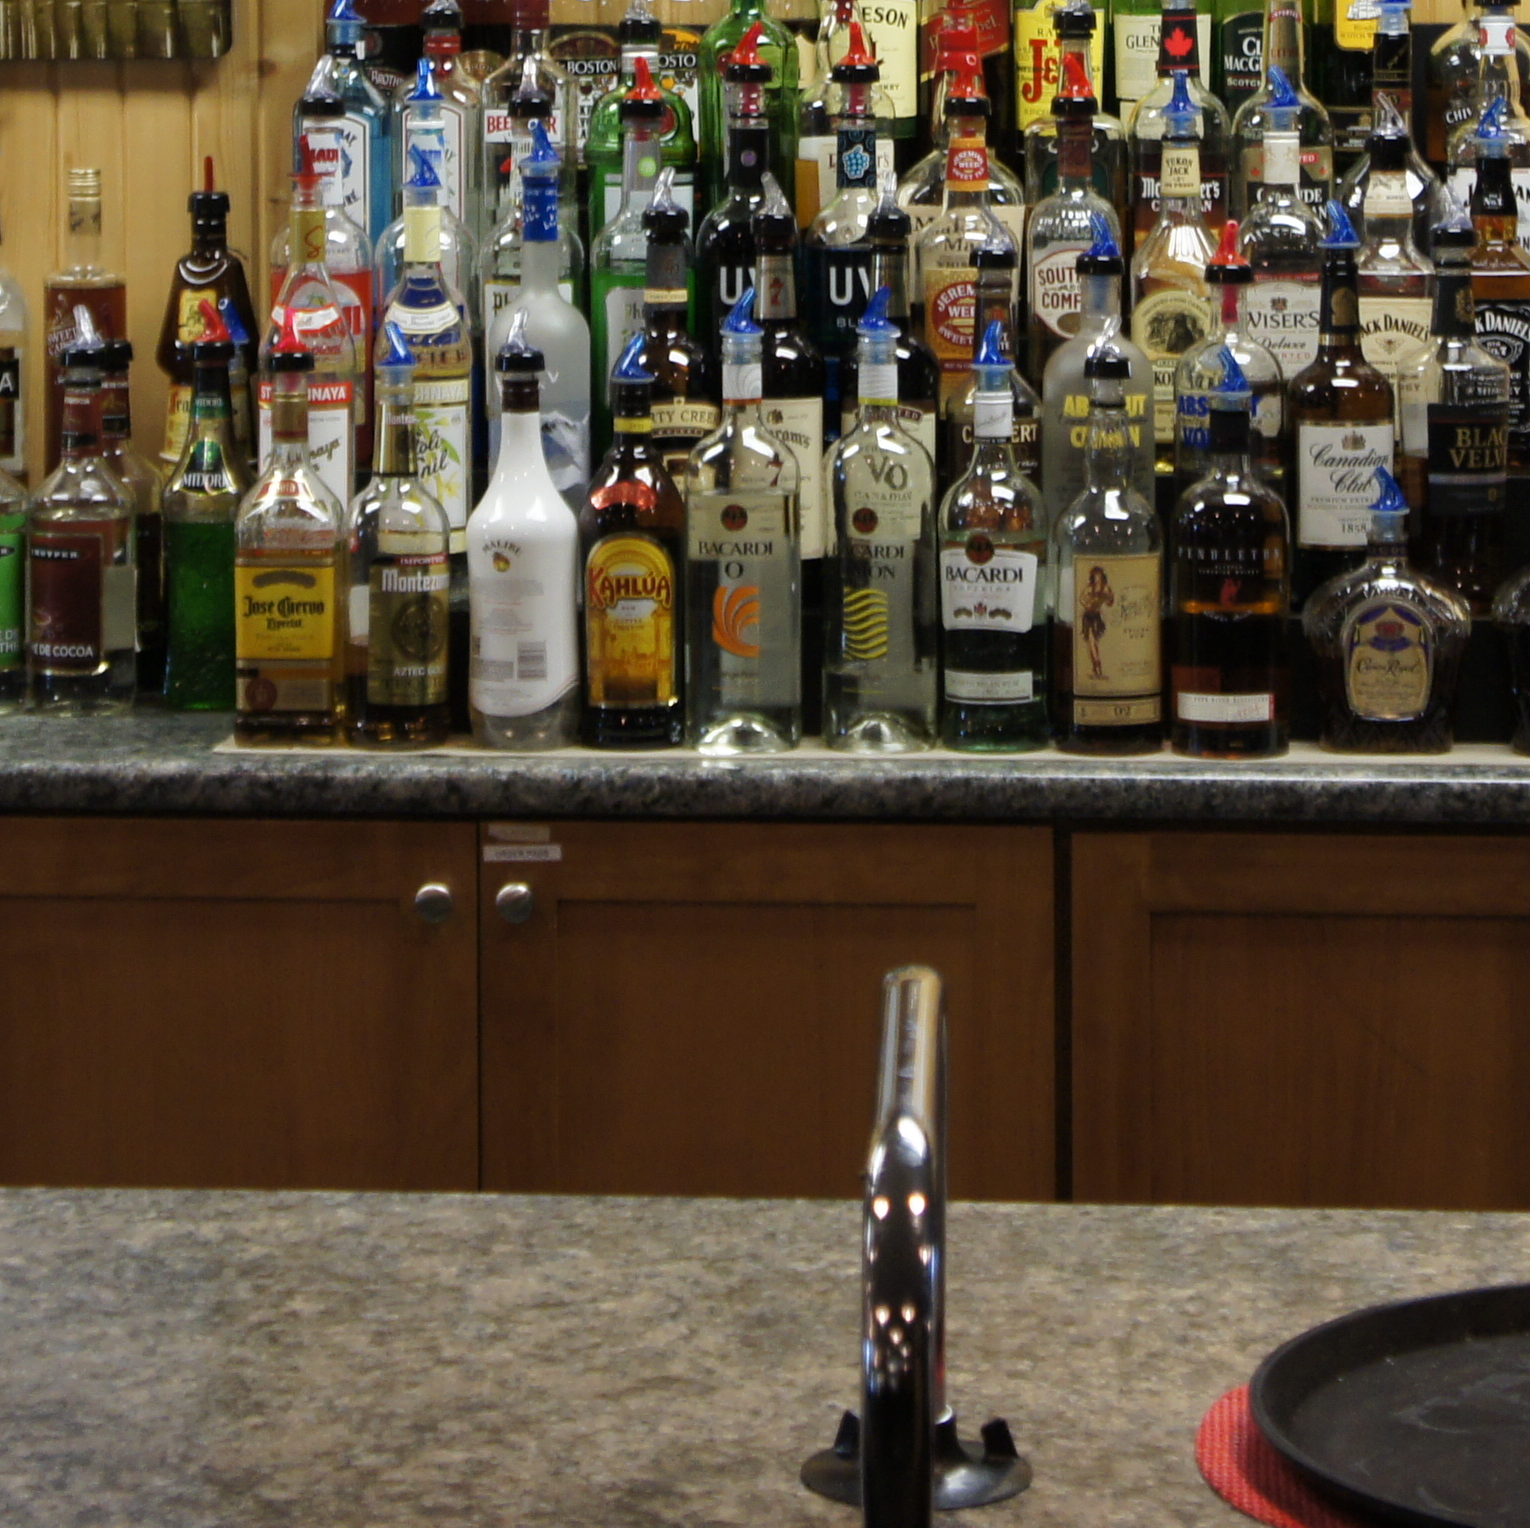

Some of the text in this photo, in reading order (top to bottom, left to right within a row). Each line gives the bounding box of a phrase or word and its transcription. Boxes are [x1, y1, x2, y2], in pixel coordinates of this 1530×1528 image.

[862, 6, 907, 29] ESON
[567, 60, 617, 74] BOSTON
[1042, 292, 1081, 310] COMF
[1309, 443, 1390, 469] Canadian
[1449, 449, 1508, 469] VELV
[865, 455, 909, 491] VO
[698, 541, 773, 556] BACARDI
[725, 561, 744, 579] O
[946, 566, 1023, 583] BACARDI
[588, 563, 671, 611] KAHLÚA
[277, 595, 325, 617] Cuervo
[52, 645, 94, 658] COCOA
